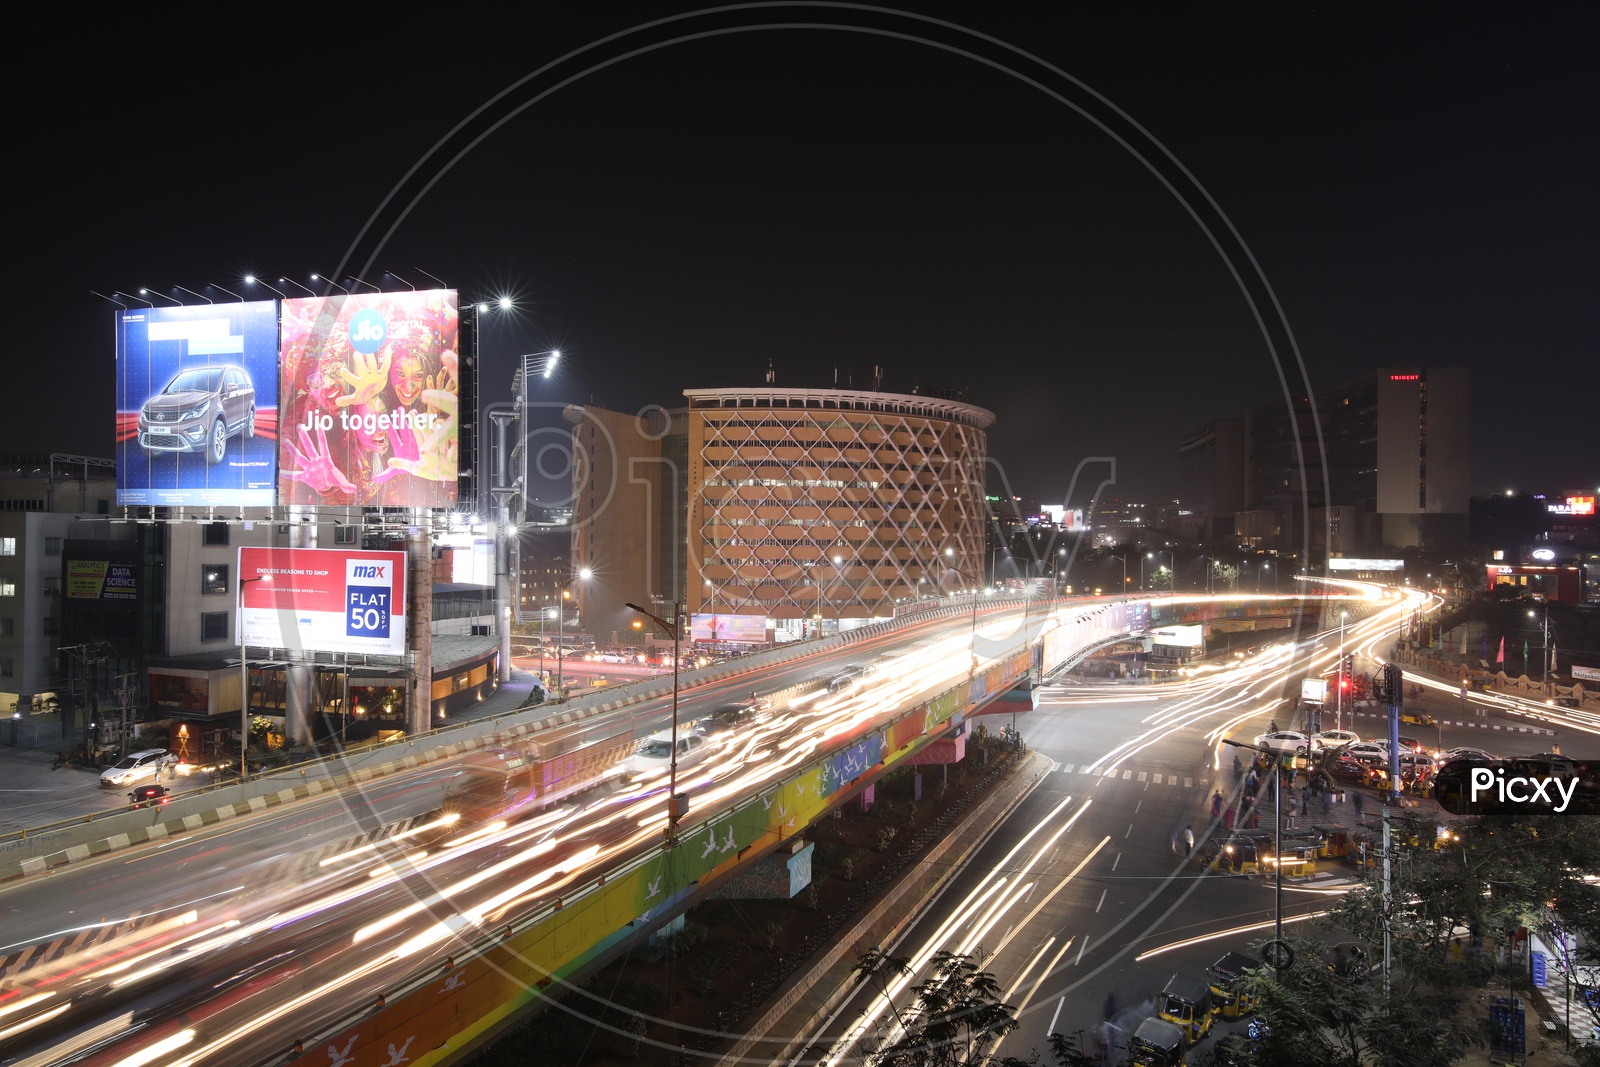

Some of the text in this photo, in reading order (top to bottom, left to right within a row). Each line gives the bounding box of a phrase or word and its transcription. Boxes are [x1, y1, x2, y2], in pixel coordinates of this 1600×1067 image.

[352, 319, 384, 341] Jio
[390, 319, 423, 331] DIGITAL
[301, 406, 442, 435] Jio together.
[112, 568, 131, 576] DATA
[353, 565, 385, 578] max
[106, 577, 136, 587] SCIENCE
[350, 592, 387, 606] FLAT
[350, 607, 380, 631] 50
